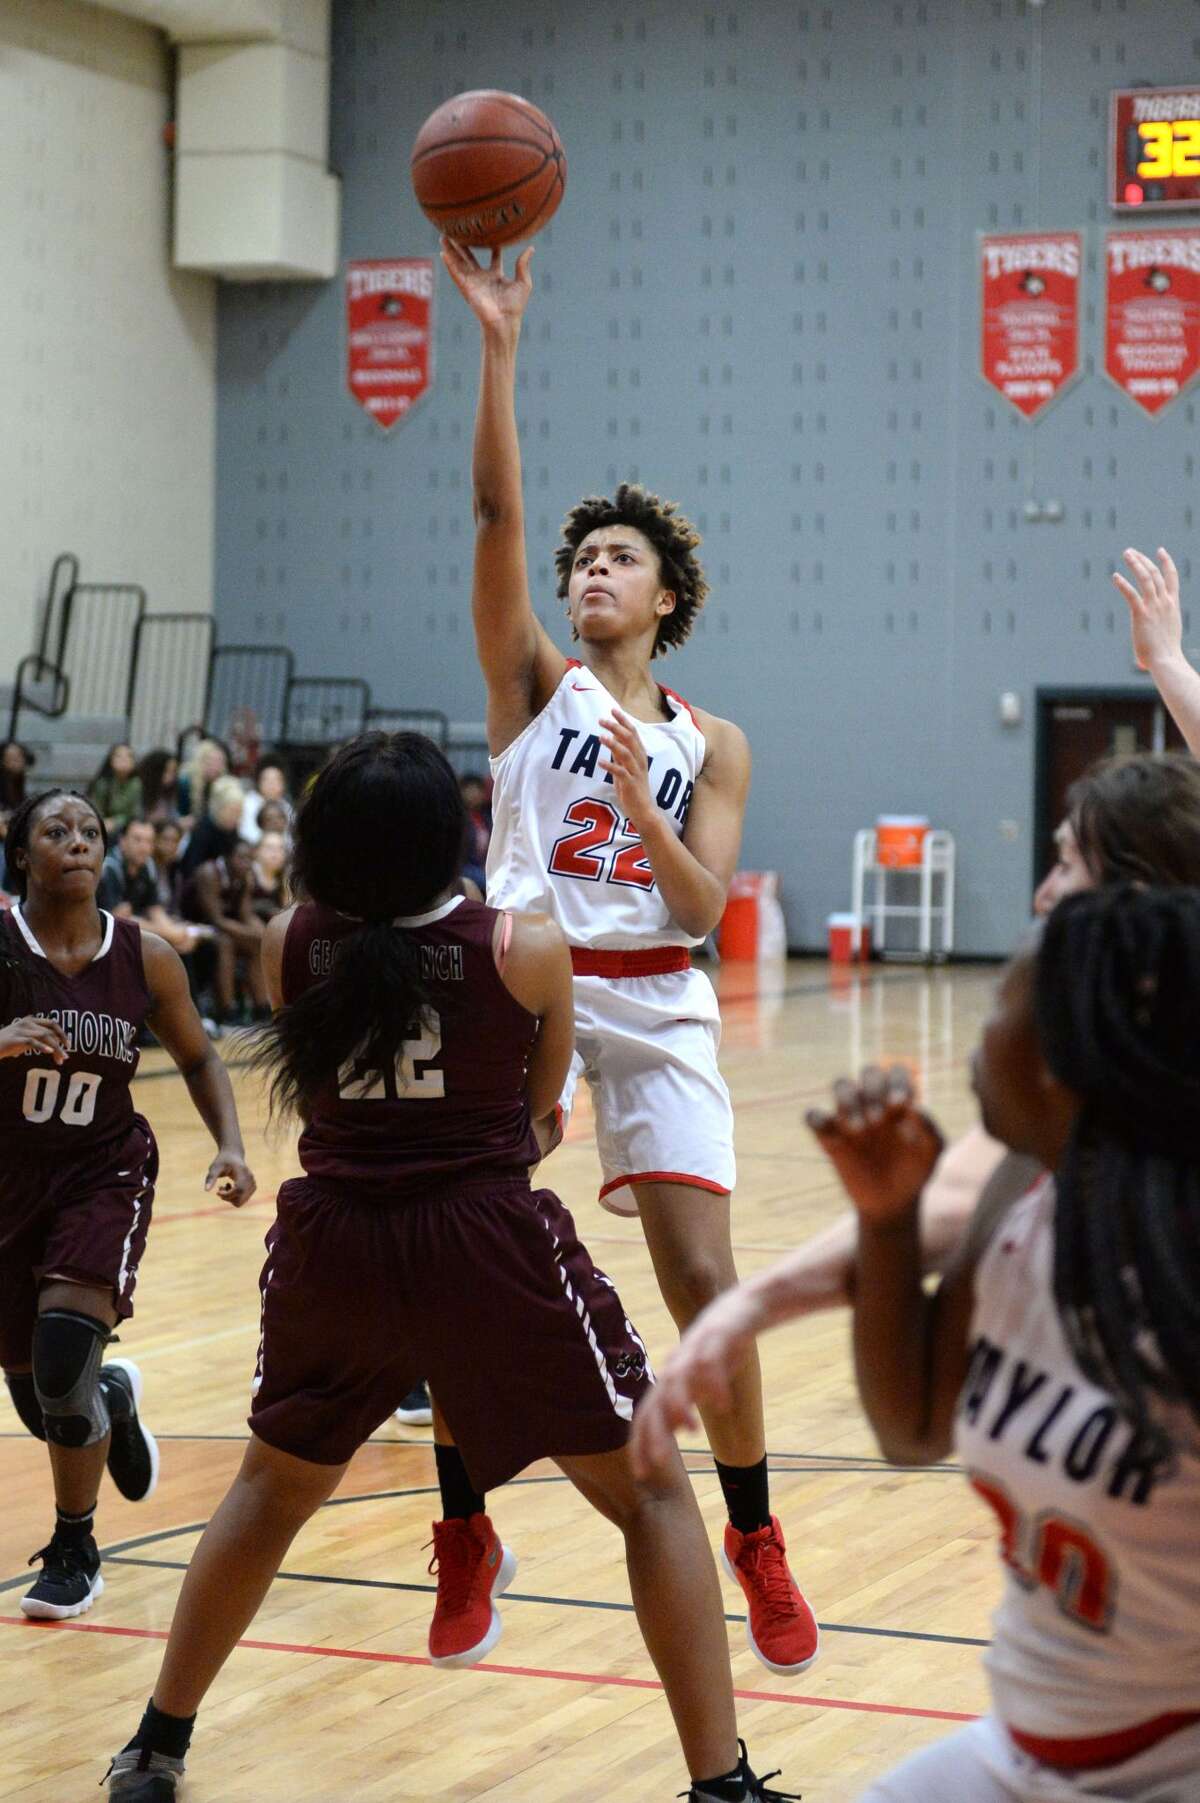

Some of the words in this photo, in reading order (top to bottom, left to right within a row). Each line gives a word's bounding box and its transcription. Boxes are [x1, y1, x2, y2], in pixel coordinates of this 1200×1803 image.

[1138, 120, 1200, 178] 32
[350, 267, 432, 299] TIGERS
[983, 242, 1079, 279] TIGERS
[1108, 238, 1200, 275] TIGERS
[551, 728, 694, 824] TAOR
[22, 1067, 103, 1127] 00
[964, 1336, 1153, 1506] AYLOR
